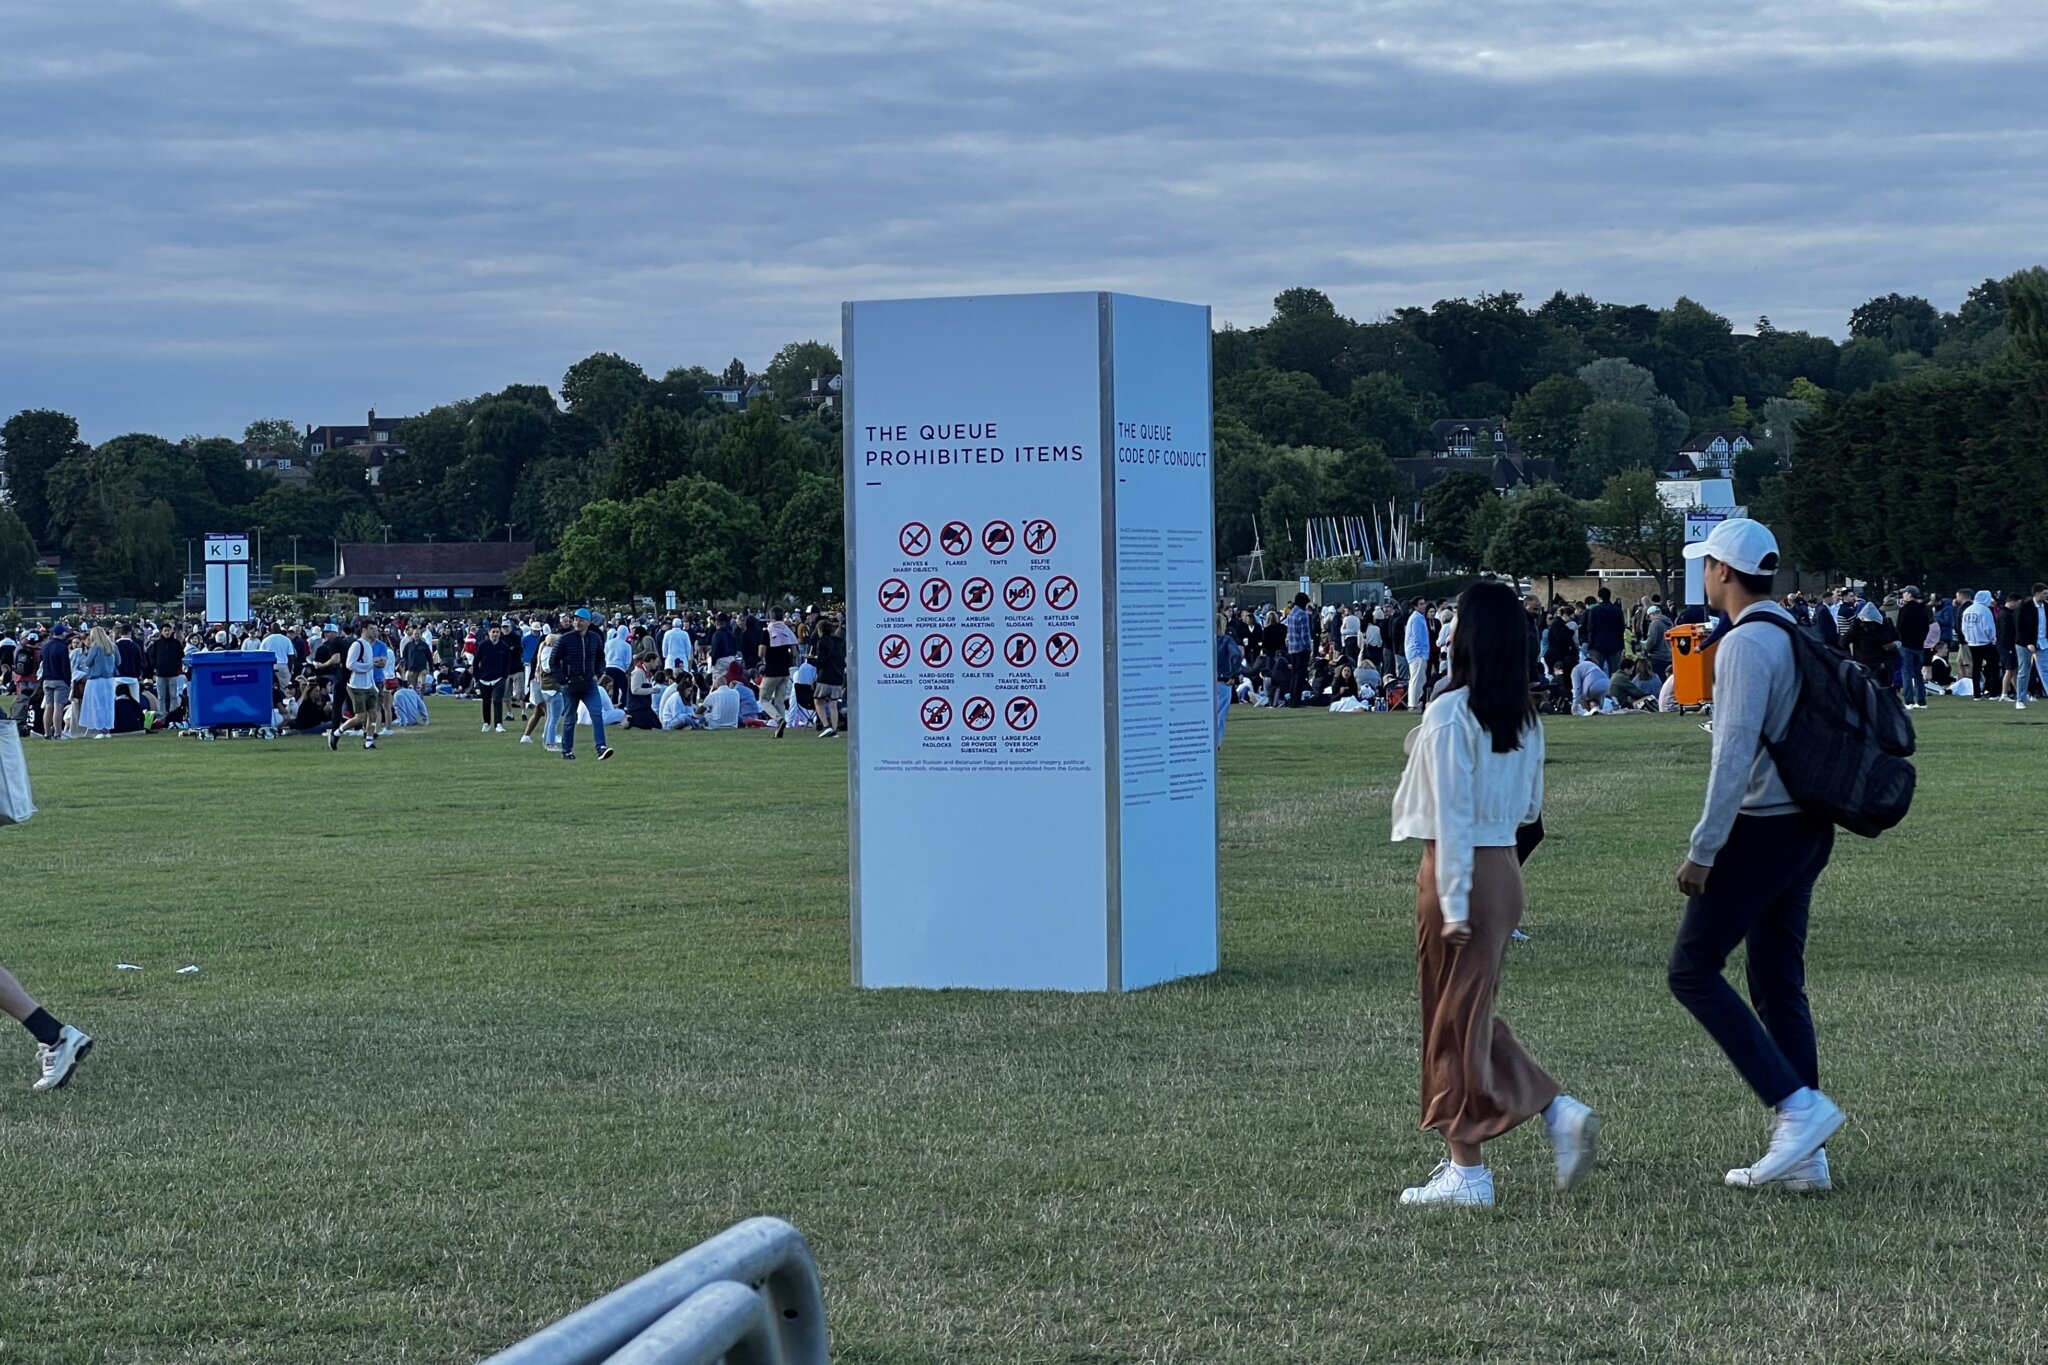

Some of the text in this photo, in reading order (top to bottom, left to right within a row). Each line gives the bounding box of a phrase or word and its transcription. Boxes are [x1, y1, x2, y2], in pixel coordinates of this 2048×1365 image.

[866, 423, 997, 441] THE QUEUE
[1118, 422, 1171, 442] THE QUEUE
[866, 445, 1083, 466] PROHIBITED ITEMS
[1119, 446, 1206, 468] CODE OF CONDUCT
[1692, 525, 1701, 536] K
[211, 544, 241, 556] K 9
[395, 590, 417, 599] CAFE
[424, 590, 448, 599] OPEN
